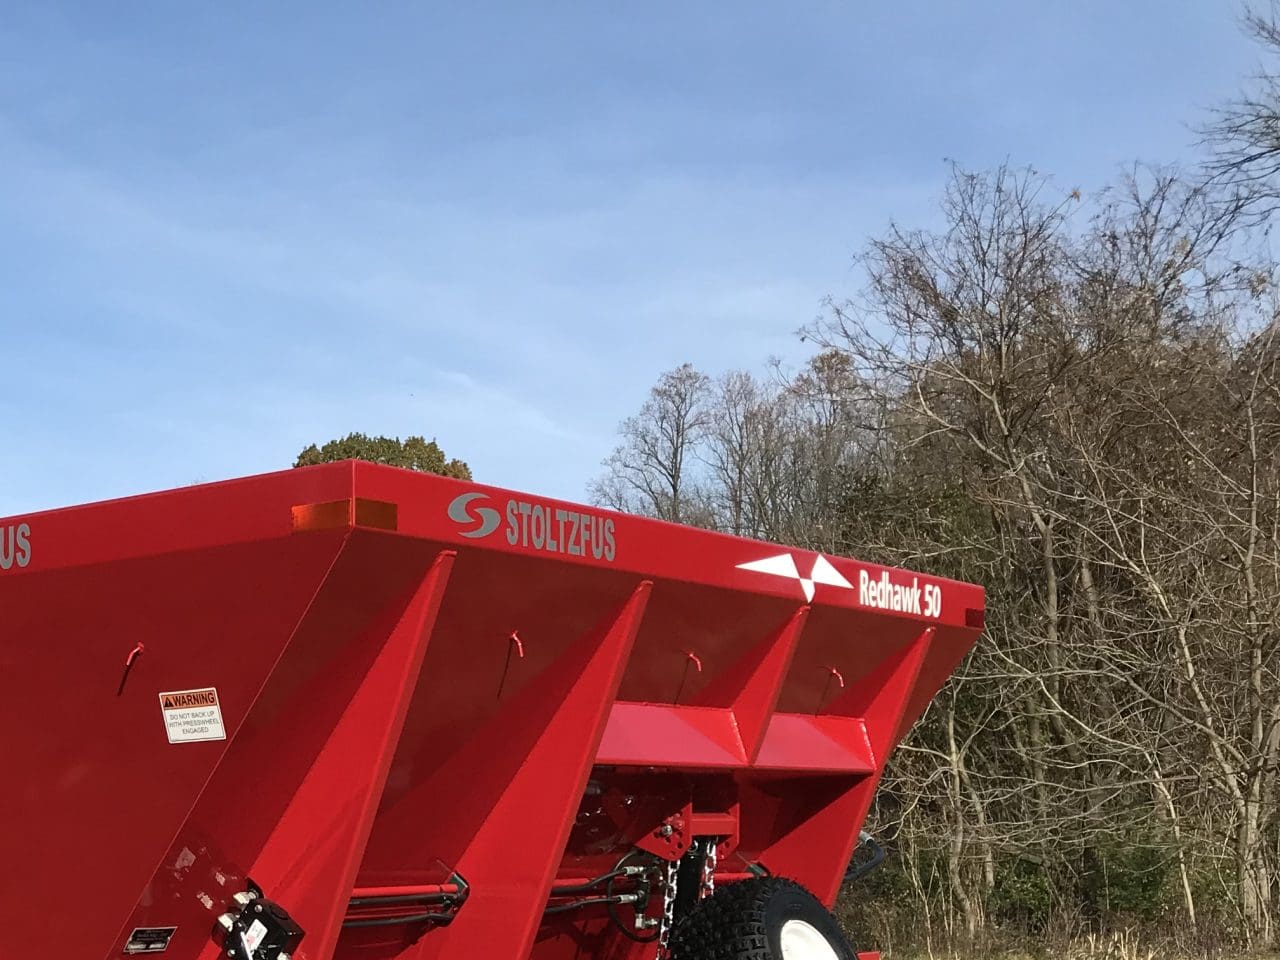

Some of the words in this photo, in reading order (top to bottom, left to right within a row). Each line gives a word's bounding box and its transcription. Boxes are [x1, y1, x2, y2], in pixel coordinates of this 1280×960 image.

[506, 499, 616, 562] STOLTZFUS
[859, 569, 921, 615] Redhawk
[924, 584, 941, 618] 50
[172, 692, 215, 707] WARNING
[182, 726, 209, 734] ENGAGED
